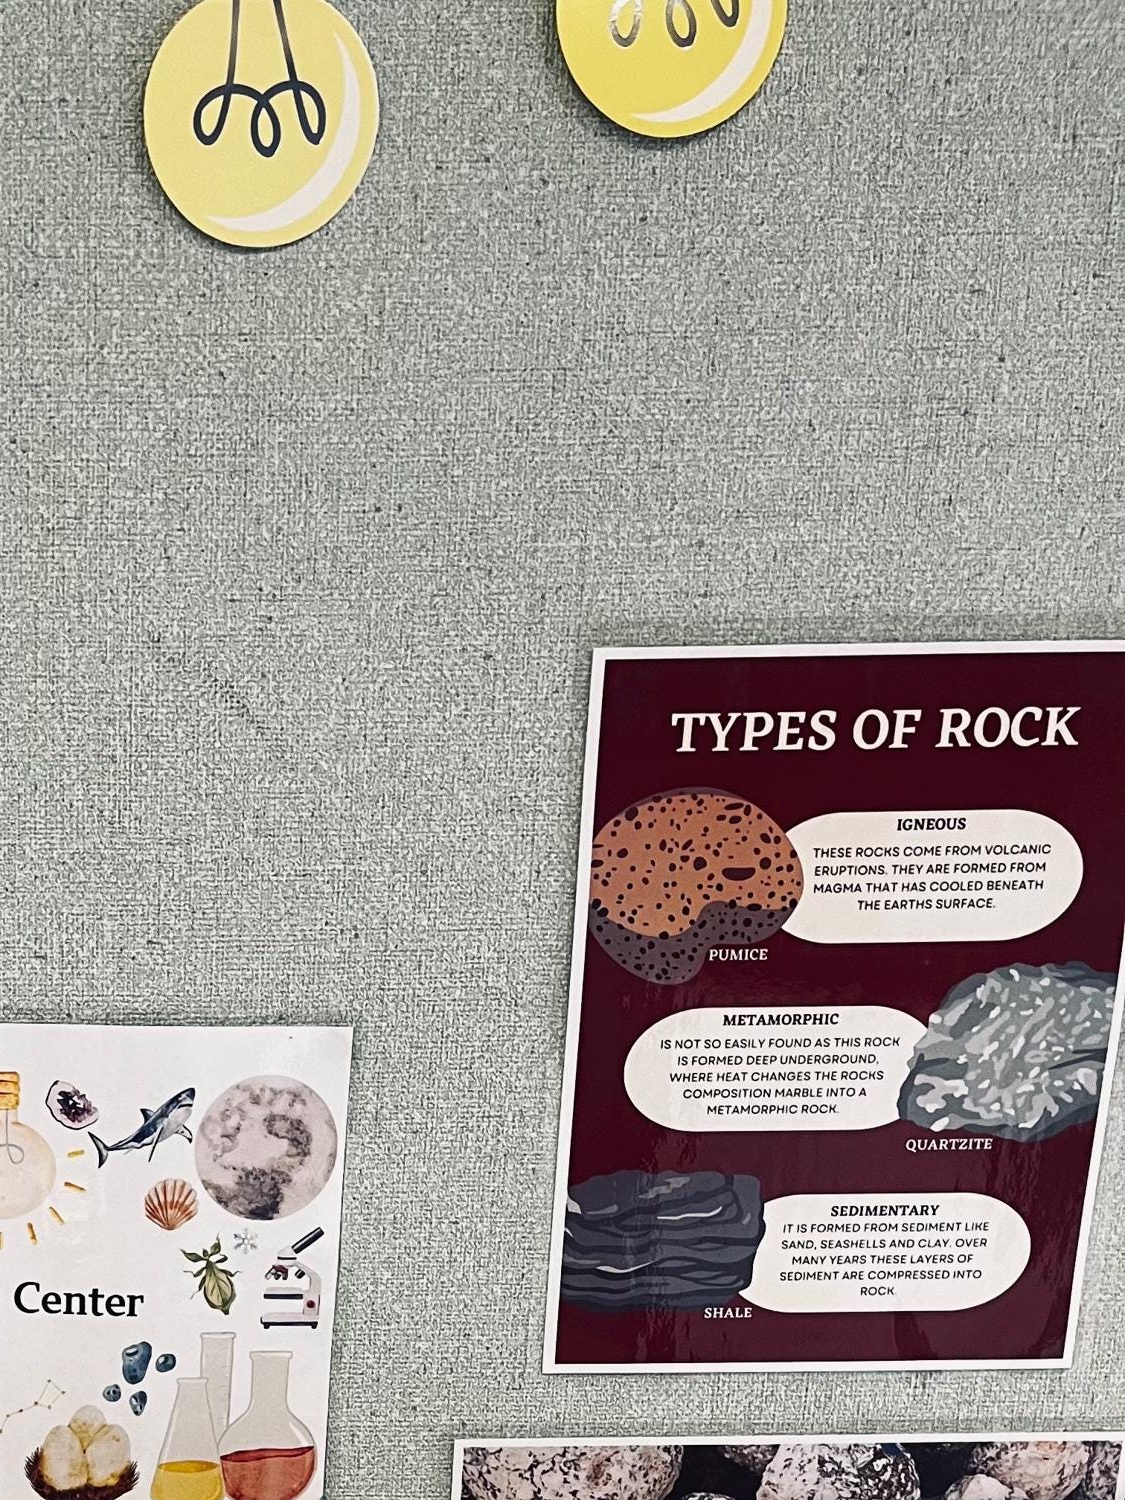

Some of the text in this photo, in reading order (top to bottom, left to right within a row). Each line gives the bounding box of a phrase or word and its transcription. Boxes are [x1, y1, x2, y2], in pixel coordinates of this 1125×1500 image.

[671, 706, 1081, 753] TYPES OF ROCK
[896, 817, 967, 831] IGNEOUS
[813, 843, 1052, 859] THESE ROCKS COME FROM VOLCANIC
[891, 863, 924, 875] THEY
[925, 863, 951, 875] ARE
[953, 862, 1007, 874] FORMED
[1009, 861, 1047, 873] FROM
[813, 879, 1044, 894] MAGMA THAT HAS COOLED BENEATH
[857, 899, 882, 911] THE
[883, 898, 933, 911] EARTHS
[708, 948, 769, 961] PUMICE
[722, 1012, 840, 1026] METAMORPHIC
[660, 1036, 901, 1050] IS NOT SO EASILY FOUND AS THIS ROCK
[677, 1053, 879, 1066] IS FORMED DEEP UNDERGROUND,
[669, 1070, 884, 1083] WHERE HEAT CHANGES THE ROCKS
[682, 1087, 867, 1100] COMPOSITION MARBLE INTO A
[706, 1104, 799, 1116] METAMORPHIC
[905, 1138, 993, 1153] QUARTZITE
[830, 1204, 940, 1217] SEDIMENTARY
[782, 1221, 989, 1234] IT IS FORMED FROM SEDIMENT LIKE
[781, 1239, 817, 1251] SAND,
[820, 1238, 887, 1250] SEASHELLS
[888, 1238, 915, 1249] AND
[954, 1237, 988, 1248] OVER
[791, 1253, 974, 1265] MANY YEARS THESE LAYERS OF
[779, 1269, 982, 1282] SEDIMENT ARE COMPRESSED INTO
[13, 1281, 145, 1317] Center
[704, 1307, 753, 1319] SHALE
